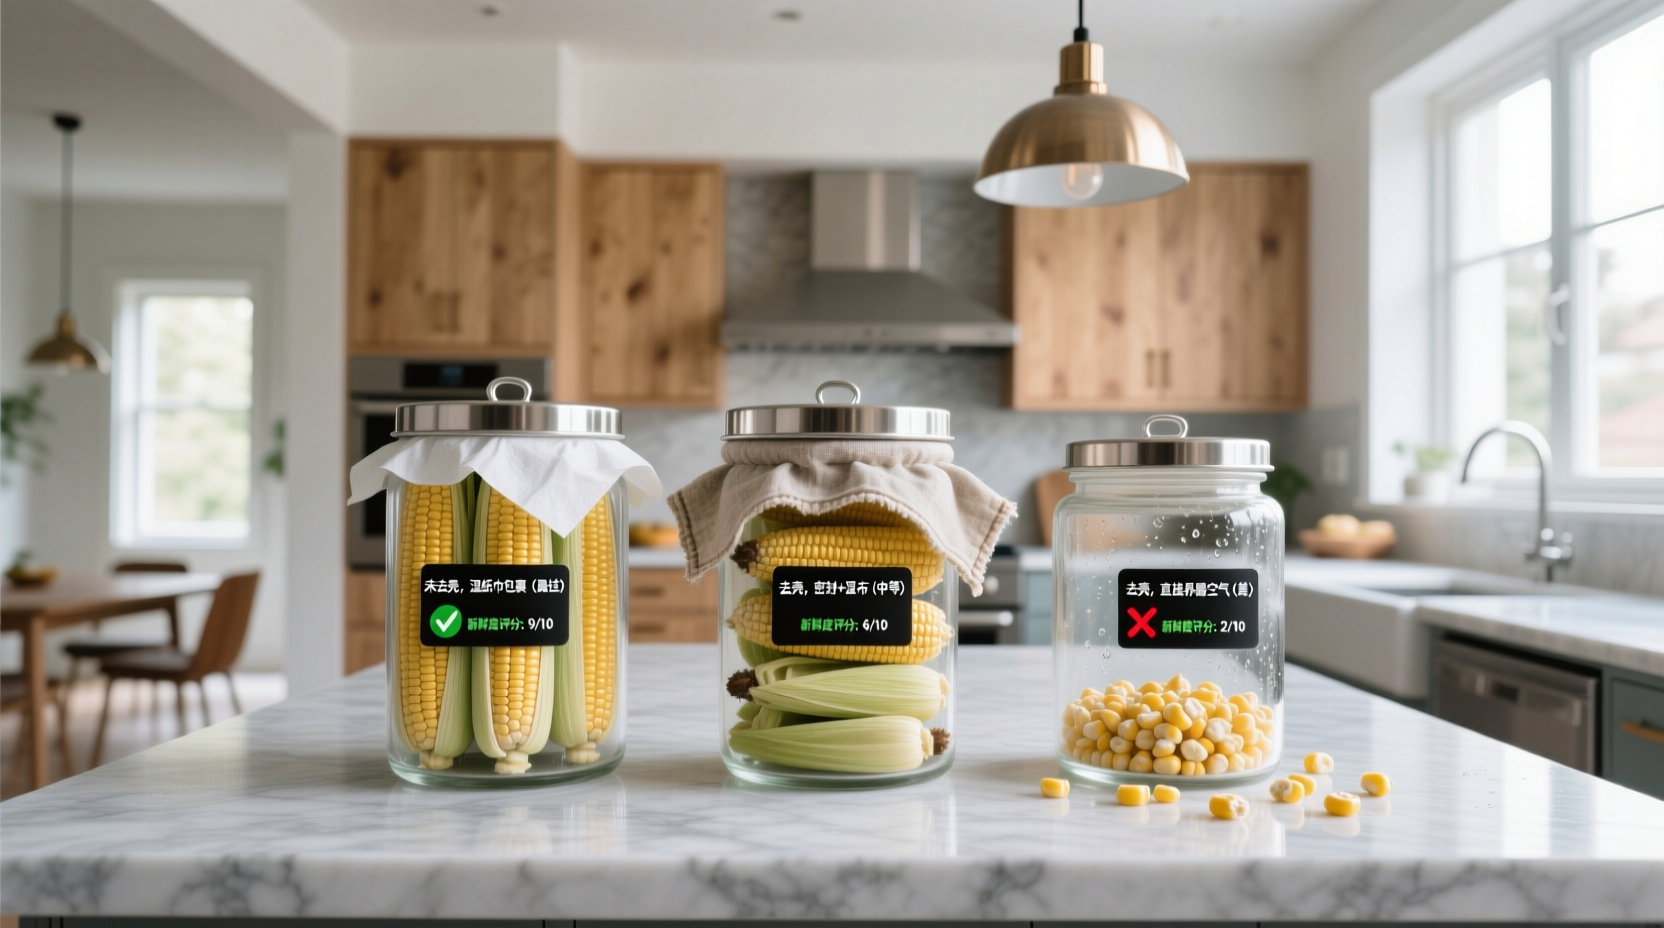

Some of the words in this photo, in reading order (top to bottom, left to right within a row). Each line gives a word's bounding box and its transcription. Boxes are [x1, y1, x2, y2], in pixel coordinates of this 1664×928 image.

[528, 617, 554, 632] 9/10
[862, 618, 889, 633] 6/10
[1220, 620, 1246, 633] 2/10
